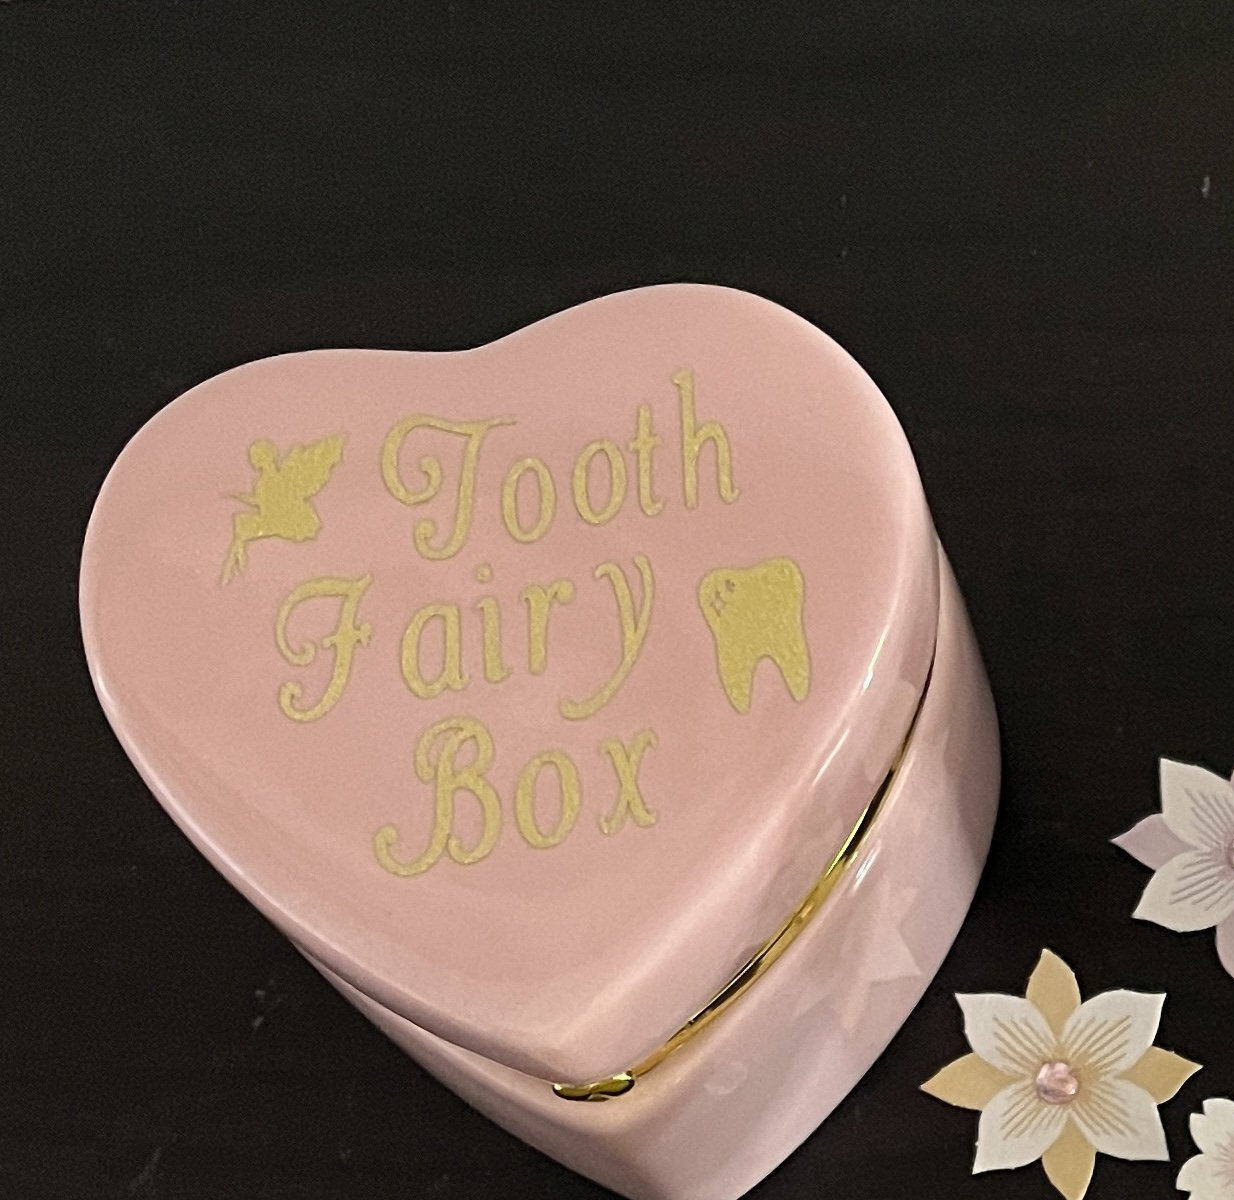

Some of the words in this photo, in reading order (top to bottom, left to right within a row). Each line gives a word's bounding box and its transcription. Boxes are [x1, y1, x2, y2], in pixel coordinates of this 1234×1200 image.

[380, 367, 740, 561] Tooth
[275, 553, 656, 723] Fairy
[373, 715, 660, 877] Box
